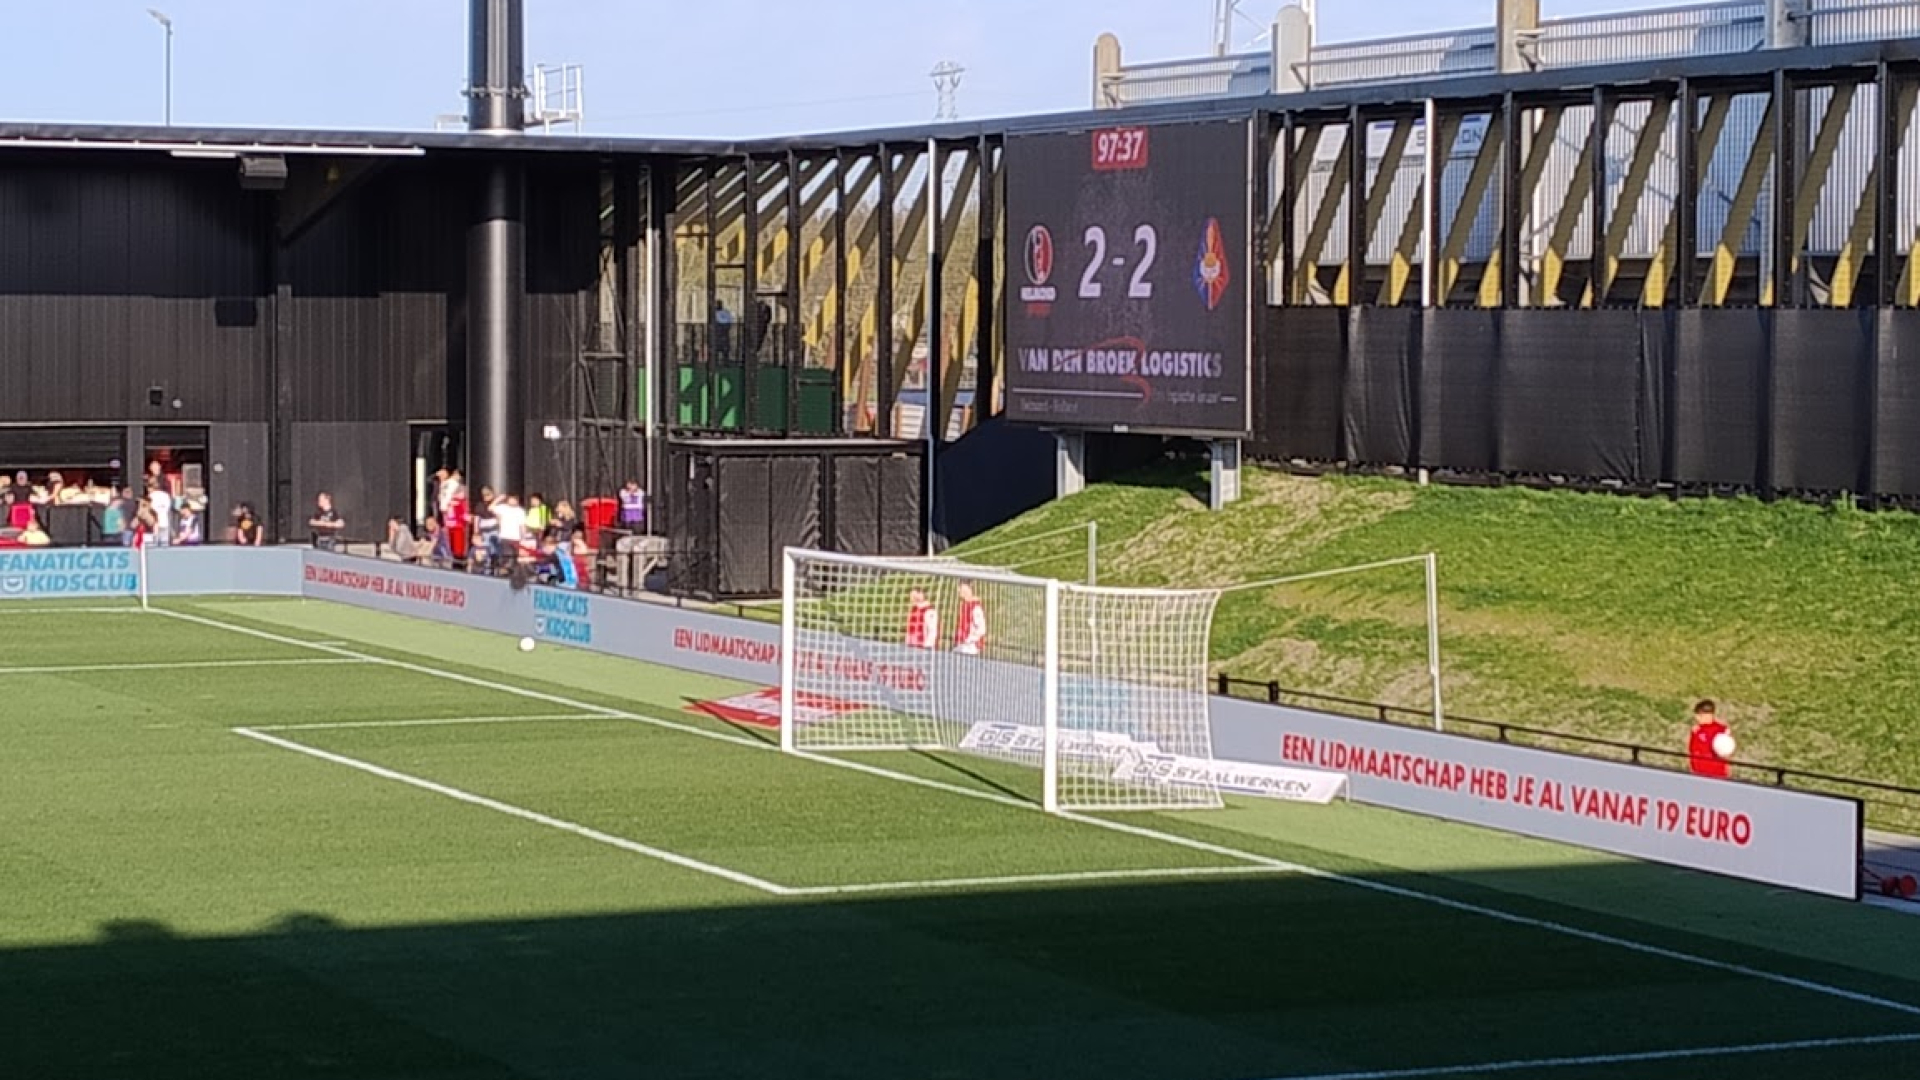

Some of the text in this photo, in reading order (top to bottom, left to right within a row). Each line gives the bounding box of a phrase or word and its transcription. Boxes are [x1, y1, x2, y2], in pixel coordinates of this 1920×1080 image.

[1097, 131, 1144, 163] 97:37
[1018, 347, 1048, 372] VAN
[1052, 348, 1083, 375] DEN
[1141, 352, 1222, 378] LOGISTICS
[0, 551, 131, 572] FANATICATS
[29, 573, 138, 592] KIDSCLUB
[674, 628, 693, 650] EEN
[695, 631, 776, 664] LIDMAATSCHAP
[1172, 766, 1312, 793] STAALWERKEN
[1281, 733, 1752, 846] EEN LIDMAATSCHAP HEB JE AL VANAF 19 EURO
